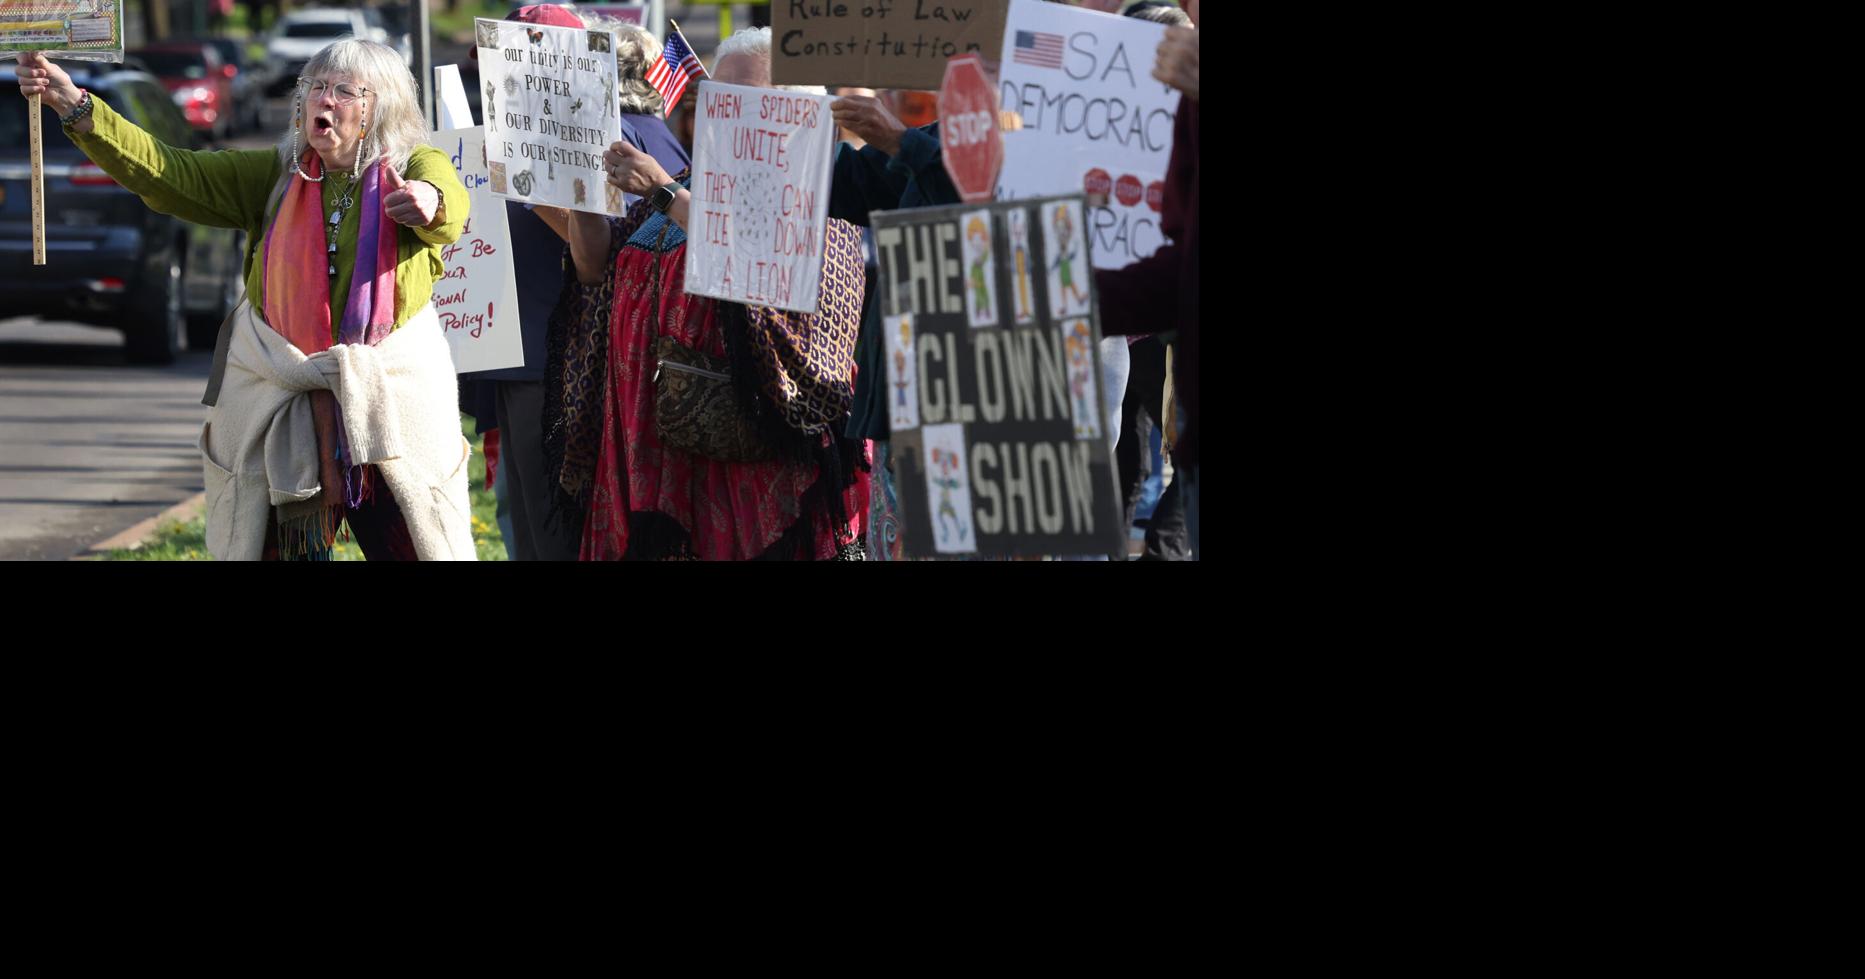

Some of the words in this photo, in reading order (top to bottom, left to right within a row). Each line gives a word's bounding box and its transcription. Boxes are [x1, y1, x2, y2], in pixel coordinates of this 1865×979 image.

[790, 0, 848, 20] Rule
[862, 0, 892, 19] of
[914, 0, 973, 21] Law
[504, 47, 524, 62] our
[530, 50, 559, 74] unity
[563, 49, 573, 70] is
[577, 56, 597, 73] our
[780, 30, 980, 58] Constitution
[525, 74, 572, 97] POWER
[543, 99, 552, 115] &
[705, 92, 742, 119] WHEN
[760, 95, 820, 129] SPIDERS
[1003, 80, 1175, 152] DEMOCRAC
[505, 112, 532, 132] OUR
[540, 118, 606, 147] DIVERSITY
[948, 111, 993, 148] STOP
[503, 141, 514, 158] IS
[520, 142, 547, 162] OUR
[734, 126, 789, 173] UNITE,
[704, 171, 737, 205] THEY
[781, 184, 815, 220] CAN
[441, 243, 462, 262] ot
[470, 239, 496, 257] Be
[705, 211, 730, 246] TIE
[774, 217, 818, 257] DOWN
[1087, 205, 1154, 259] RAC
[722, 255, 733, 298] A
[746, 260, 794, 306] LION
[878, 223, 962, 315] THE
[439, 302, 493, 338] Policy!
[918, 329, 1070, 424] CLOWN
[971, 441, 1095, 535] SHOW
